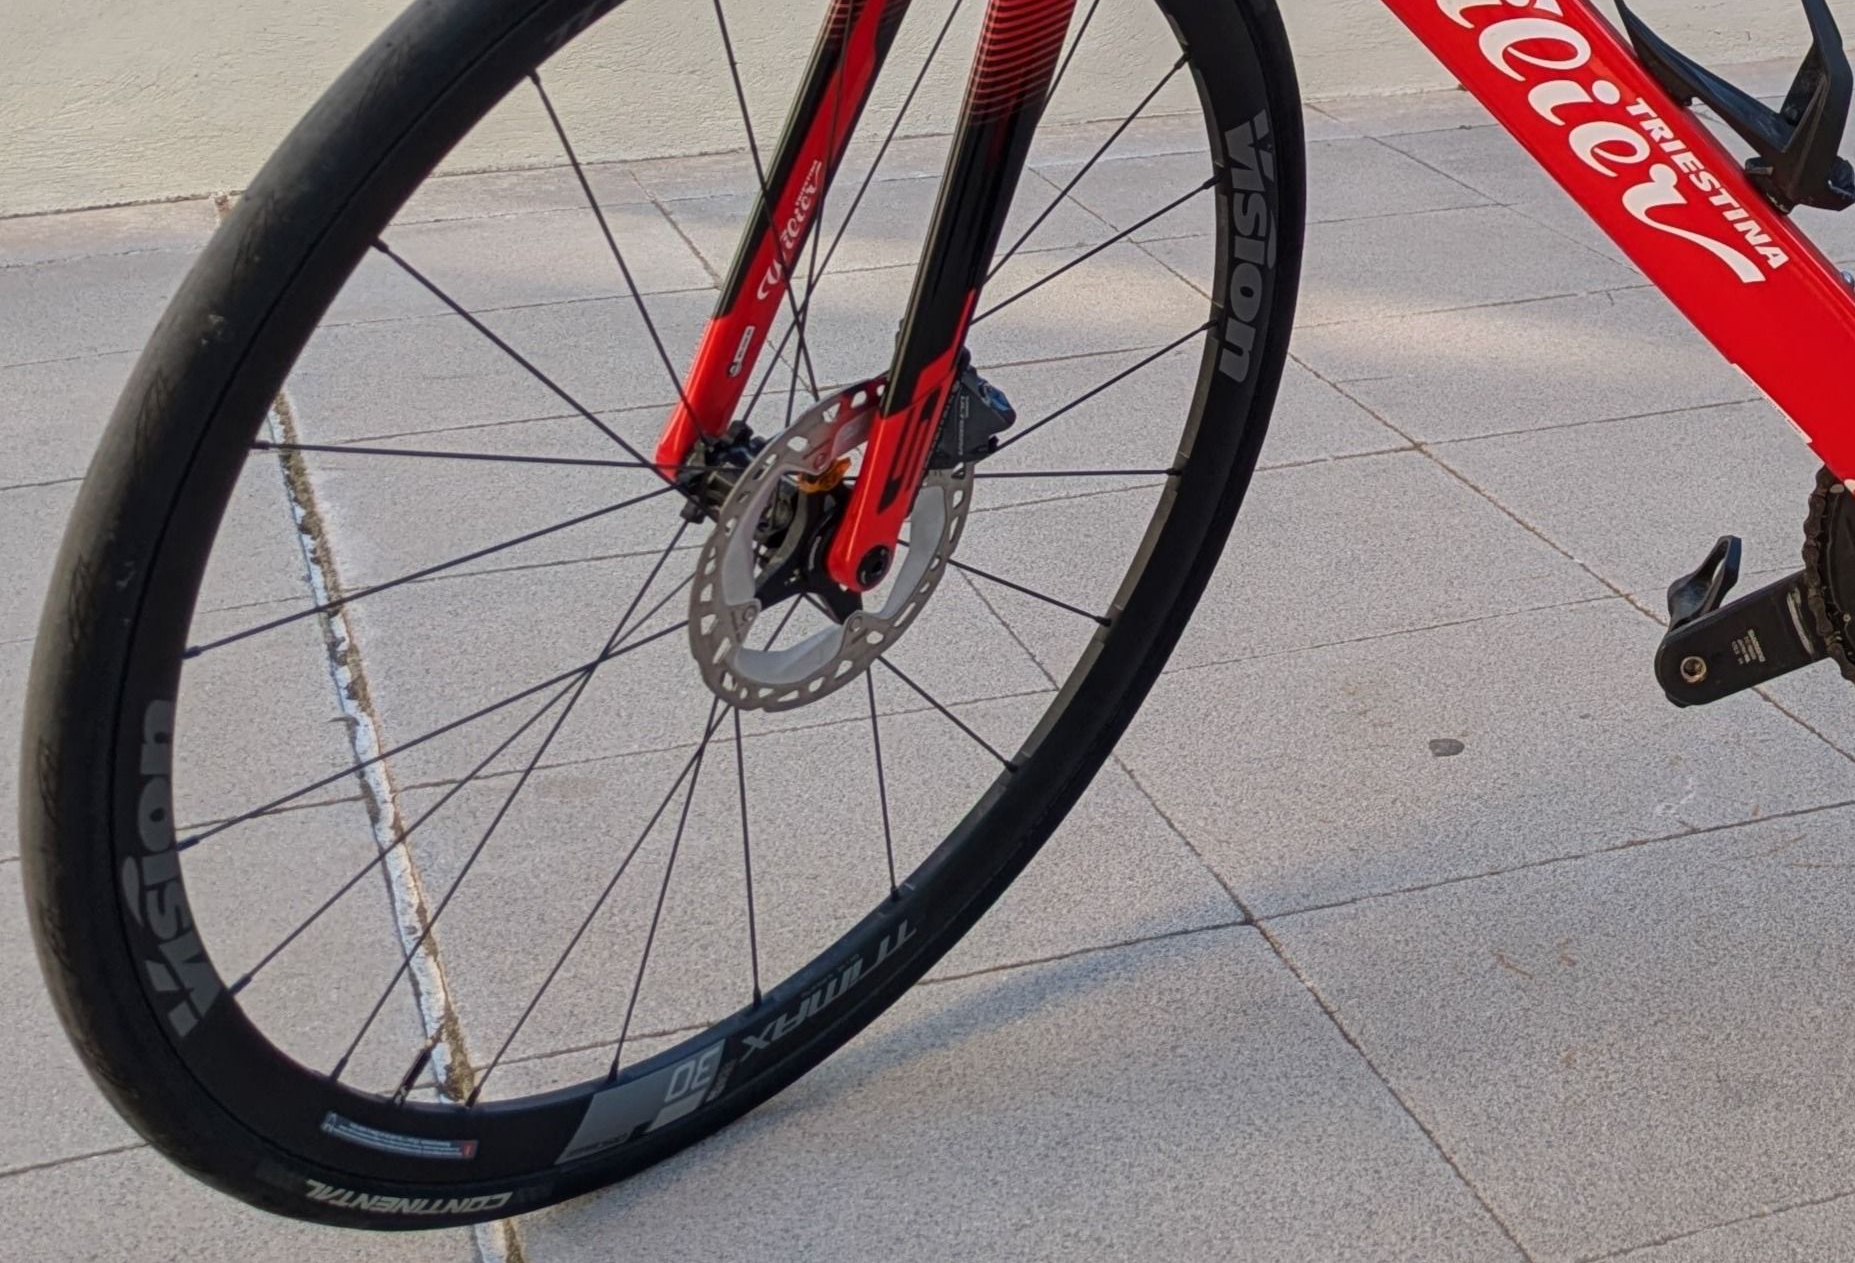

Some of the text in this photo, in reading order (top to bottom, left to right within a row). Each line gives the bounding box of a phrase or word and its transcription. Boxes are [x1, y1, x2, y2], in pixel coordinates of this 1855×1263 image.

[1626, 97, 1790, 270] TRIESTINA
[663, 1046, 722, 1104] 30
[306, 1179, 514, 1216] CONTINENTAL
